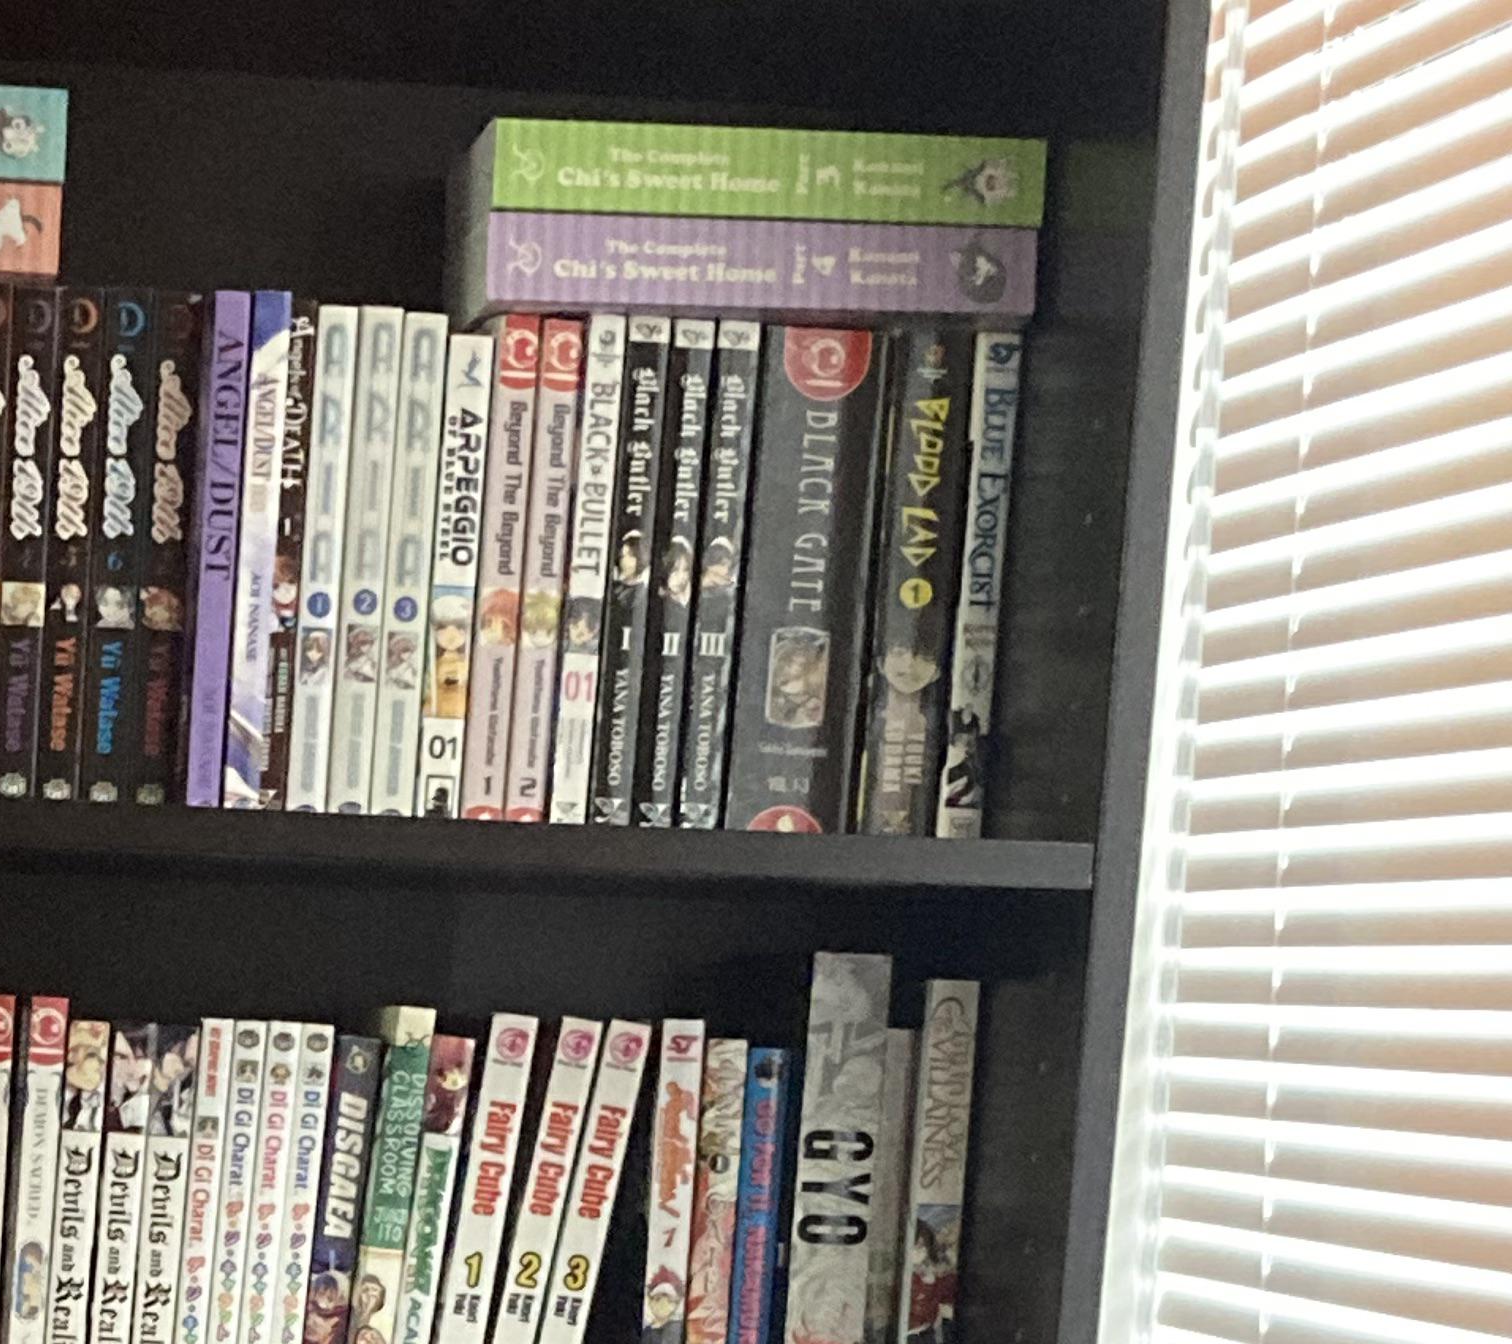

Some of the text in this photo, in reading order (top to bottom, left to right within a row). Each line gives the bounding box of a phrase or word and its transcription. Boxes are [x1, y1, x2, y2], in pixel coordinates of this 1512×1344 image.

[557, 167, 780, 195] Chi's Sweet Home
[553, 258, 777, 286] Chi's Sweet Home
[451, 407, 483, 566] ARPEGGIO
[539, 403, 571, 578] Beyond Beyond
[573, 383, 618, 575] BLACK BULLET
[789, 410, 838, 613] BLACK GATE
[967, 388, 1017, 608] BLUE EXORCIST
[899, 506, 939, 567] LAD
[564, 671, 594, 702] 01
[429, 735, 458, 760] 01
[651, 722, 670, 792] TOBOSO
[694, 723, 712, 792] TOBOSO
[229, 1133, 250, 1186] Charat
[261, 1135, 282, 1189] Charat
[294, 1135, 316, 1189] Charat
[323, 1092, 368, 1239] DISGAEA
[379, 1070, 410, 1195] CLASSROOM
[396, 1072, 428, 1198] DISSOLVING
[61, 1144, 95, 1243] Devils
[103, 1147, 140, 1245] Devils
[147, 1149, 183, 1247] Devils
[465, 1100, 518, 1288] Fairy Cube 1
[515, 1101, 579, 1289] Fairy Cube 2
[564, 1104, 629, 1291] Fairy Cube 3
[797, 1129, 875, 1246] GYO
